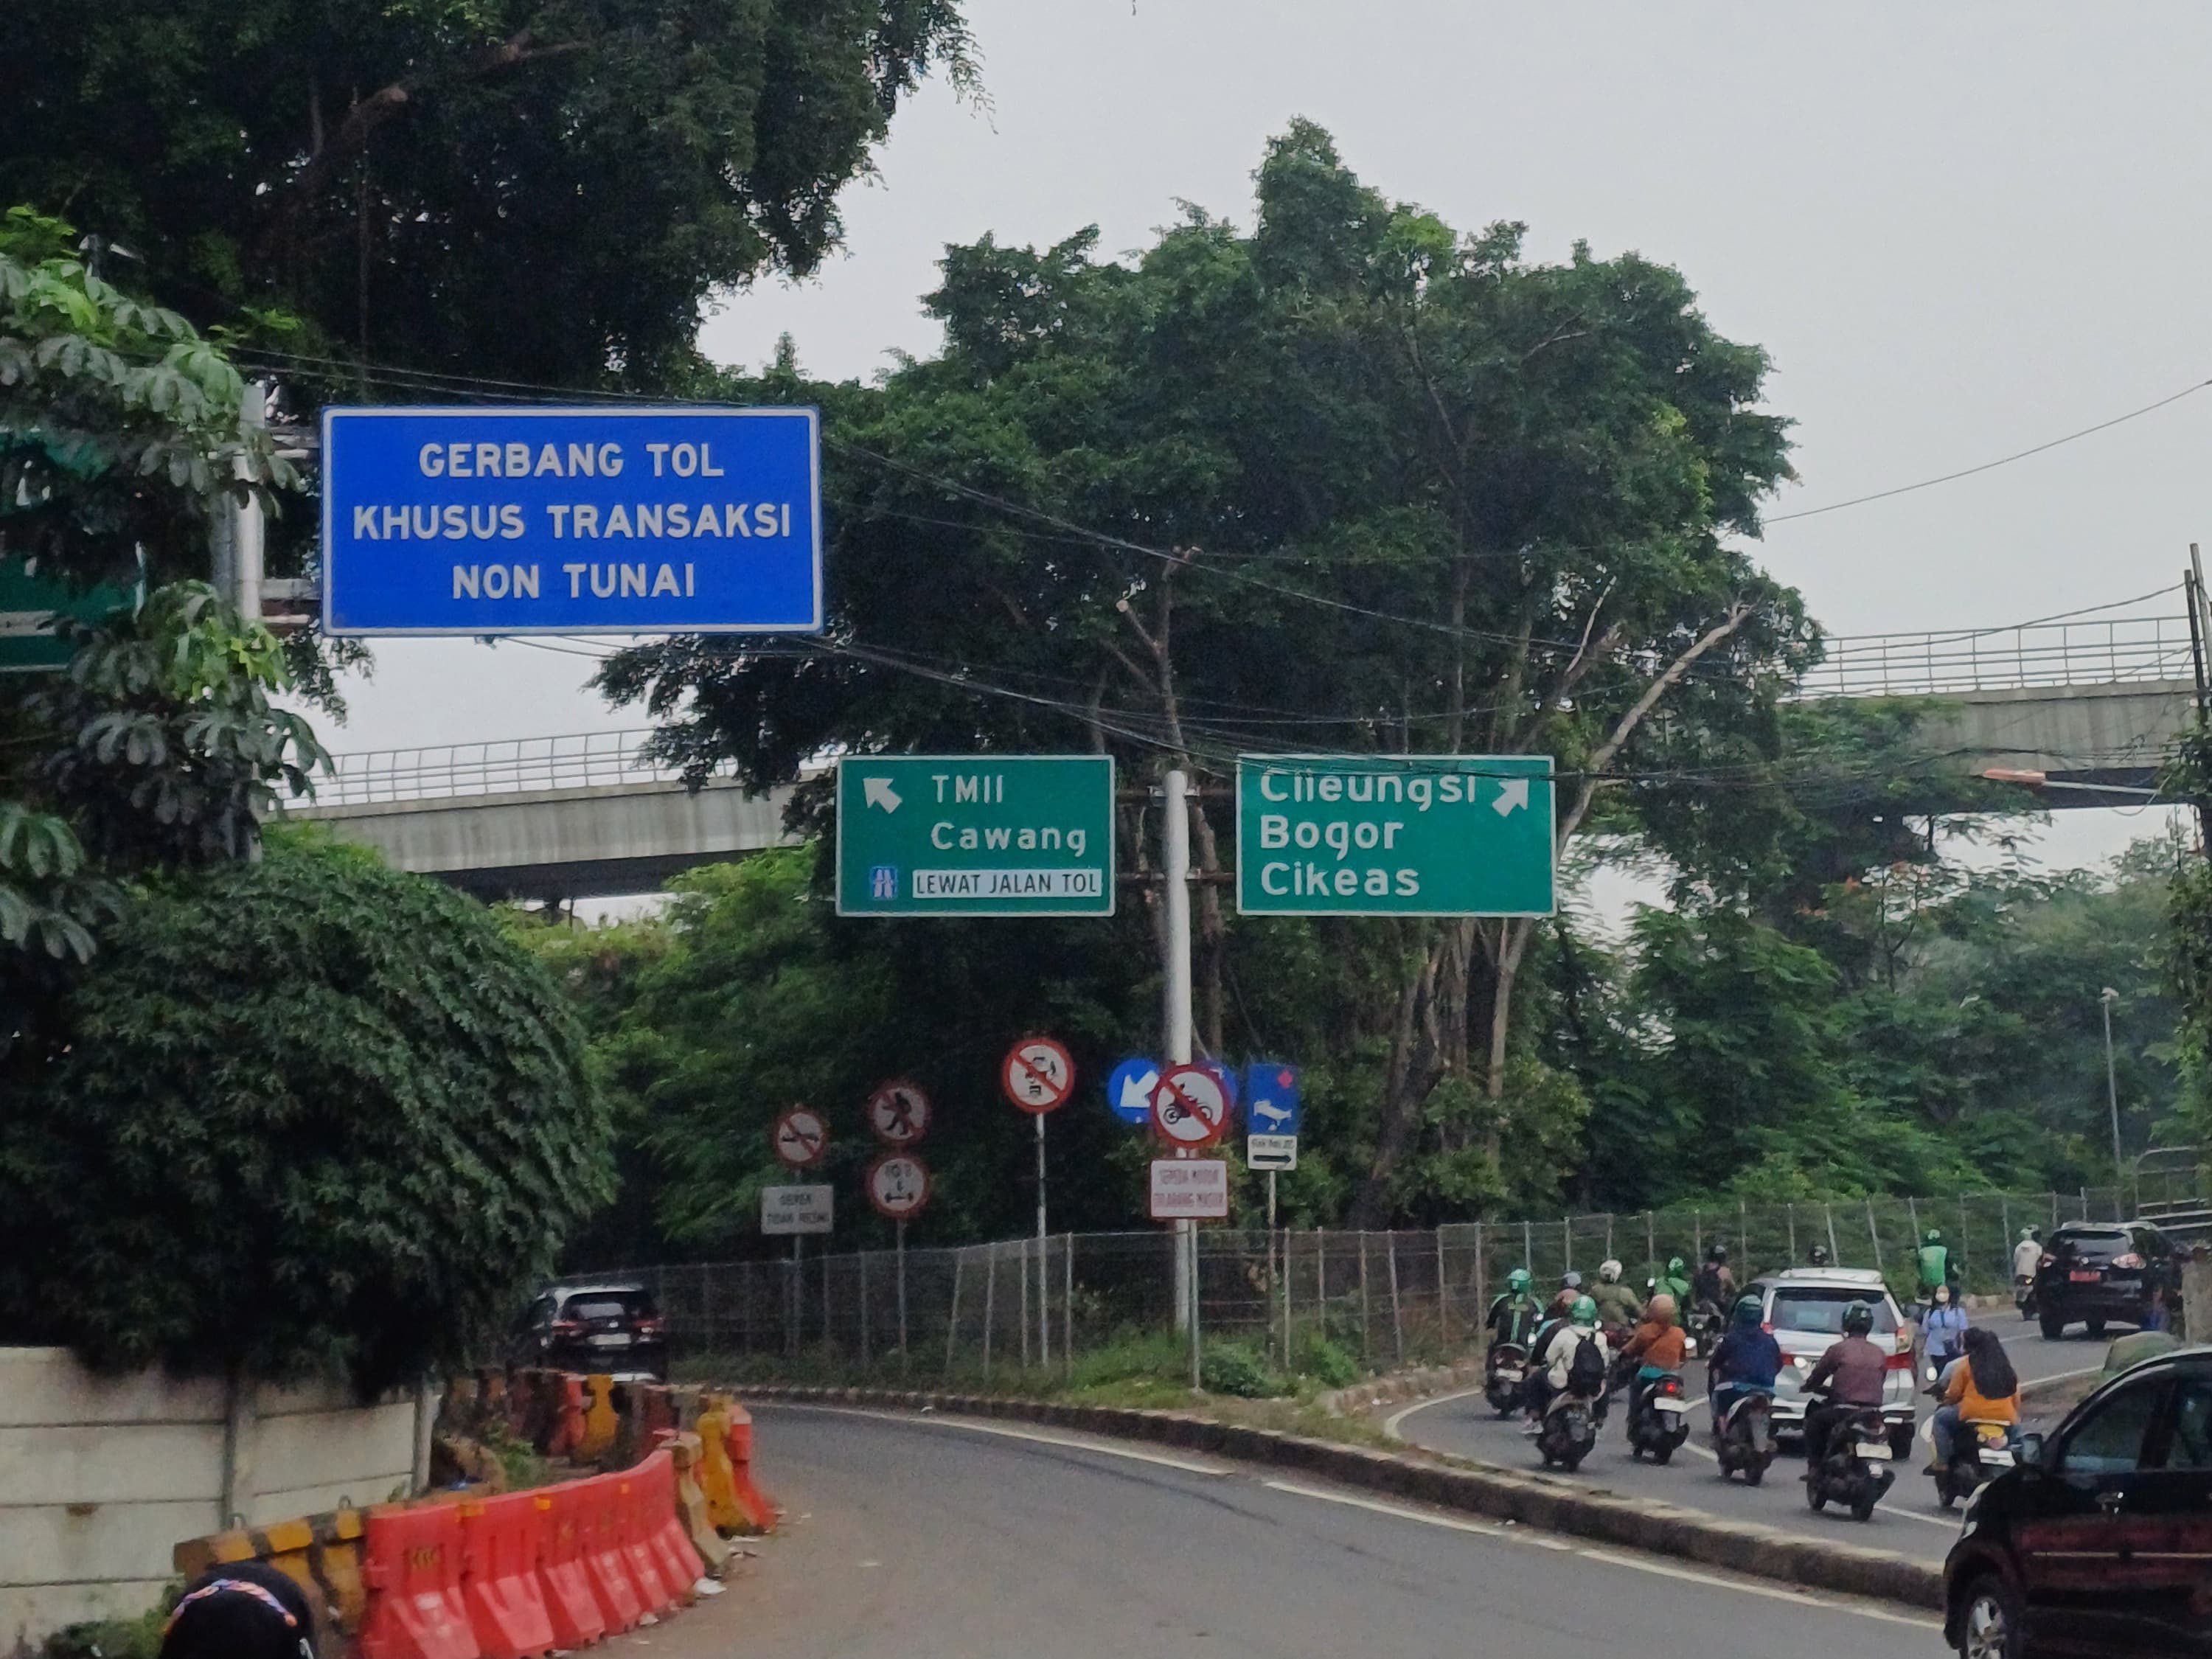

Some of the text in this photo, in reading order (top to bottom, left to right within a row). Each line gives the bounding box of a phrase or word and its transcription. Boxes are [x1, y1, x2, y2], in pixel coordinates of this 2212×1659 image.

[420, 442, 724, 477] GERBANG TOL
[353, 503, 790, 540] KHUSUS TRANSAKSI
[453, 563, 695, 599] NON TUNAI
[931, 774, 1004, 804] TMII
[931, 821, 1086, 858] Cawang
[1260, 815, 1405, 860] Bogor
[917, 873, 1096, 894] LEWAT JALAN TOL
[1261, 861, 1420, 897] Cikeas
